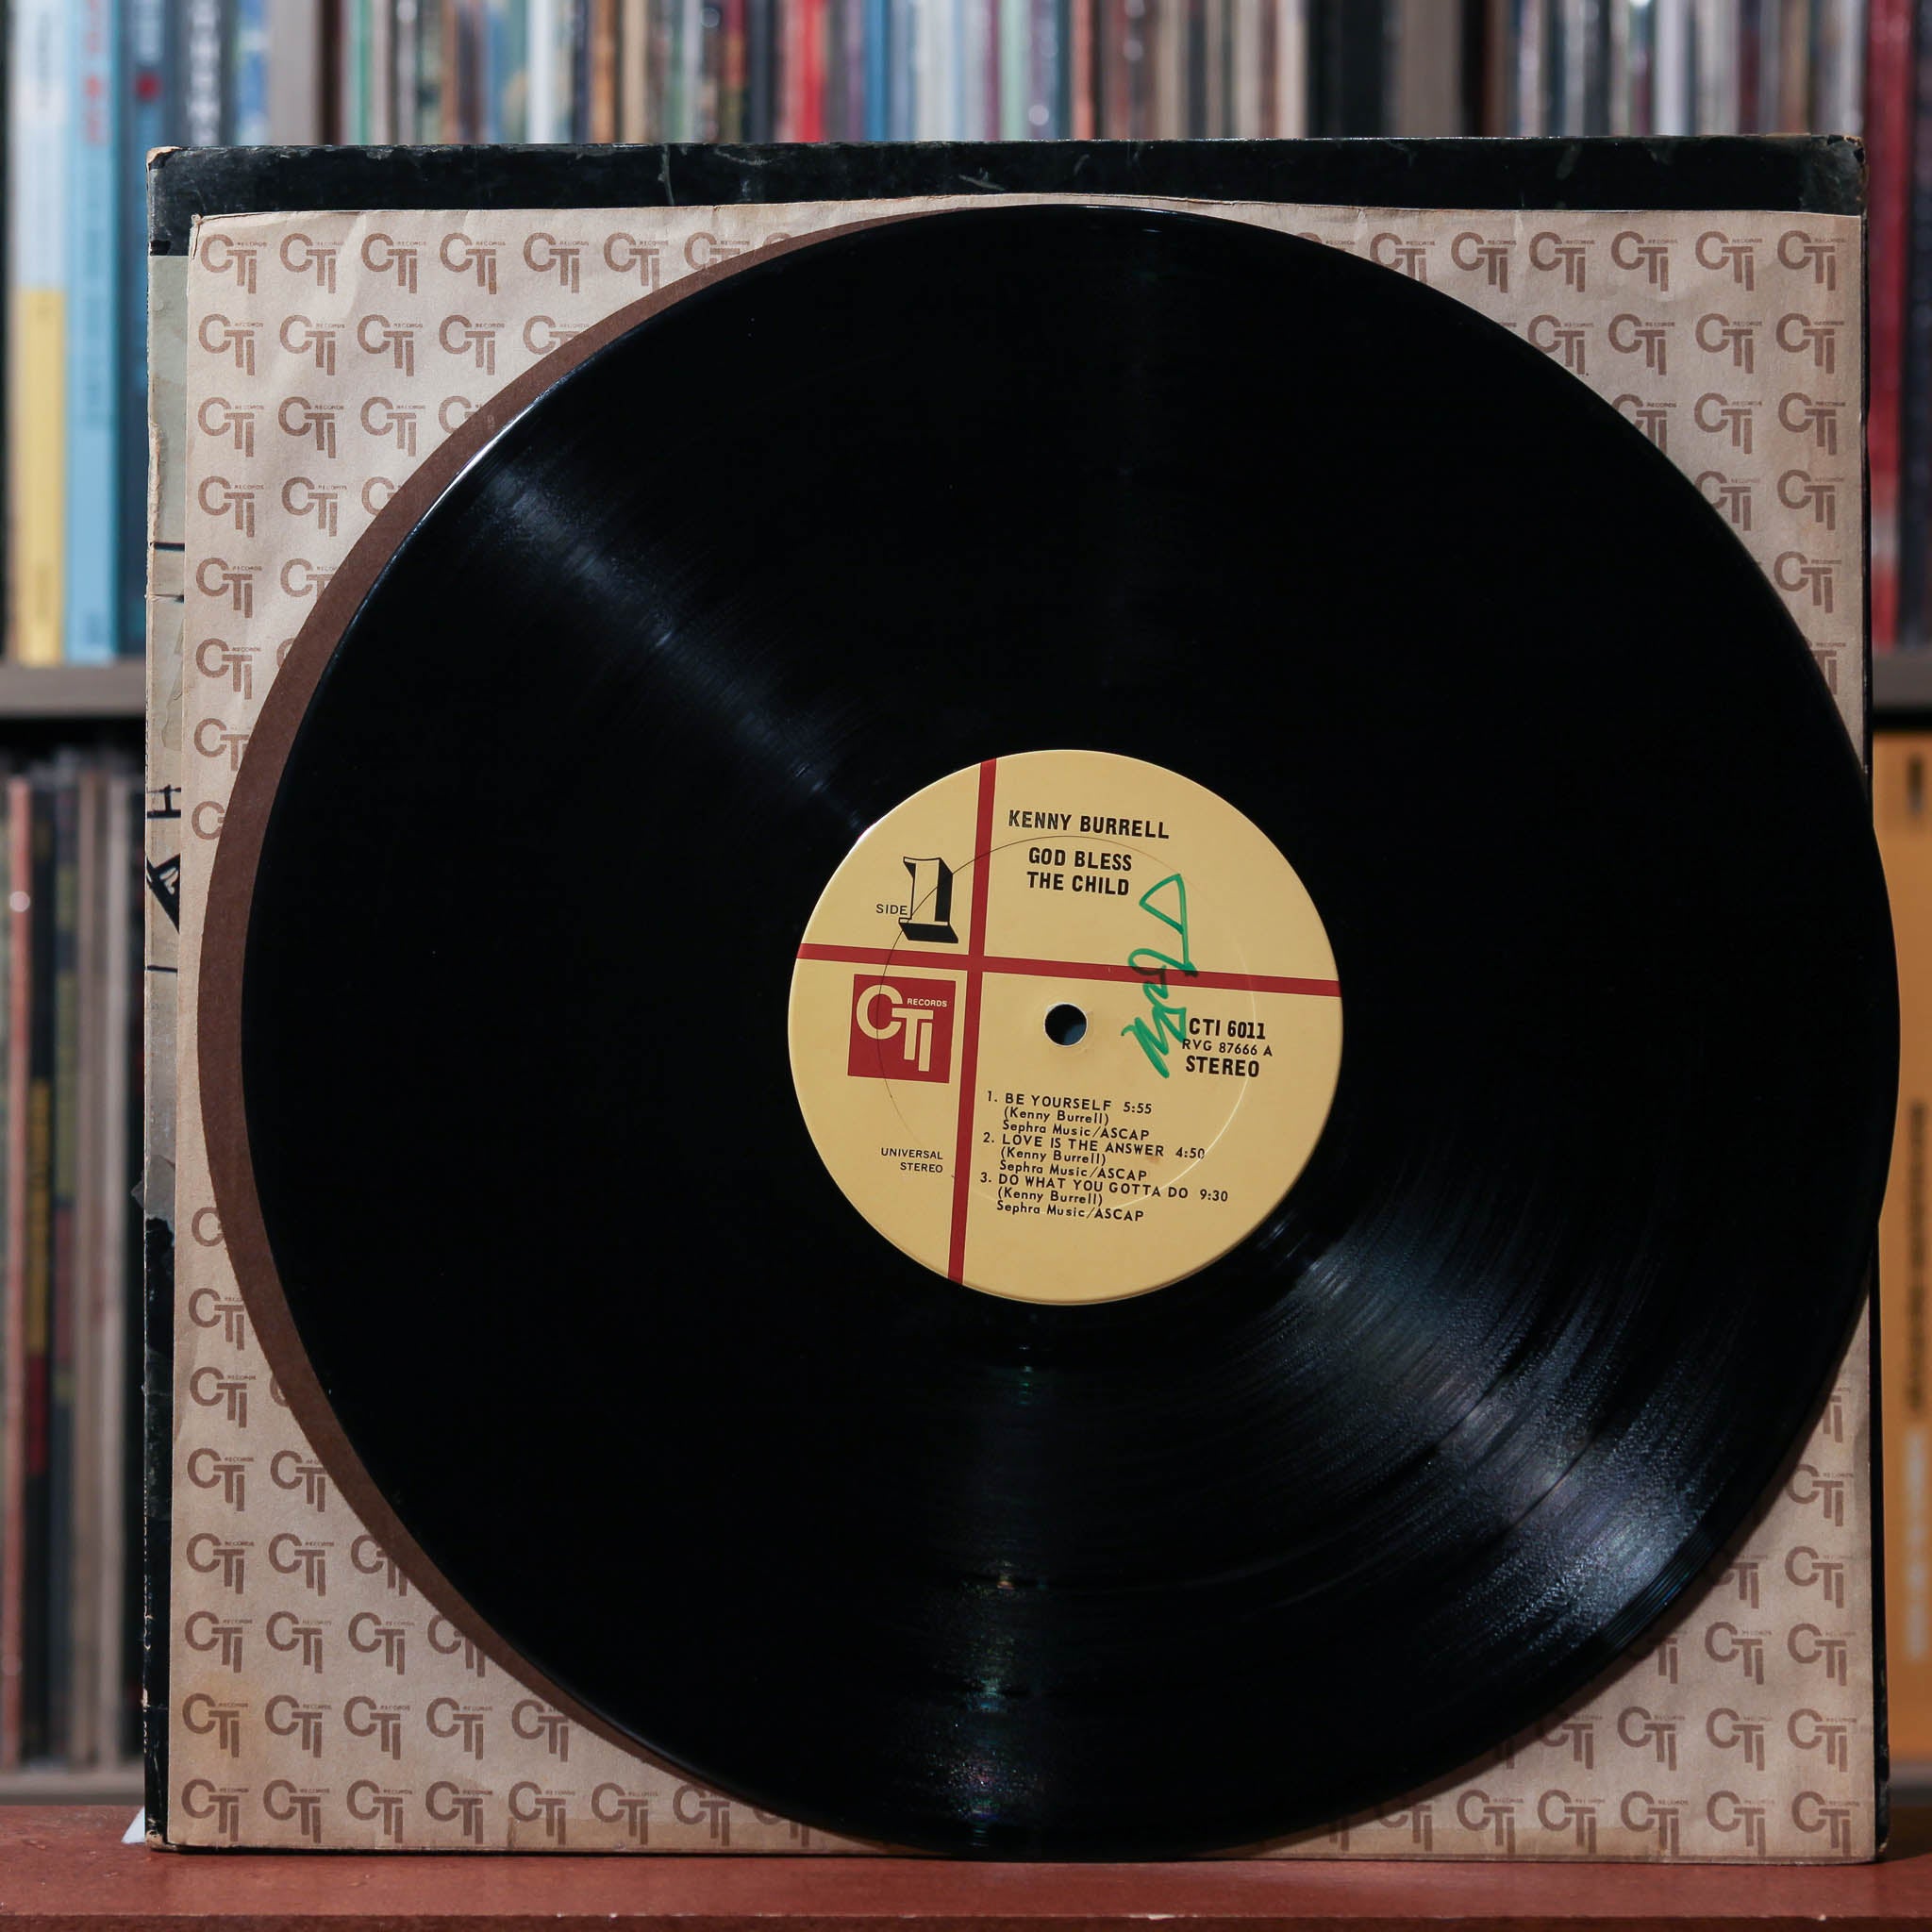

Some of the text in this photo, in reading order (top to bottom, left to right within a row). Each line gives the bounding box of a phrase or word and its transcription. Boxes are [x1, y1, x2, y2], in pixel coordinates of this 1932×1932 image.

[201, 235, 257, 293] CTI
[280, 233, 336, 293] CTI
[361, 233, 417, 293] CTI
[440, 233, 496, 294] CTI
[524, 233, 579, 292] CTI
[604, 232, 659, 291] CTI
[1370, 232, 1426, 282] CTI
[1451, 232, 1507, 293] CTI
[1529, 232, 1585, 292] CTI
[1611, 231, 1668, 291] CTI
[1695, 231, 1754, 291] CTI
[1777, 231, 1836, 291] CTI
[199, 314, 255, 375] CTI
[280, 315, 335, 375] CTI
[358, 315, 414, 376] CTI
[440, 315, 495, 375] CTI
[1528, 315, 1585, 375] CTI
[1608, 314, 1666, 375] CTI
[1696, 313, 1754, 374] CTI
[1776, 313, 1835, 374] CTI
[198, 398, 254, 457] CTI
[278, 397, 336, 458] CTI
[360, 397, 416, 456] CTI
[1694, 393, 1752, 454] CTI
[1778, 392, 1837, 455] CTI
[198, 476, 255, 538] CTI
[282, 477, 337, 537] CTI
[1695, 471, 1751, 530] CTI
[1777, 470, 1835, 530] CTI
[196, 558, 252, 618] CTI
[1774, 552, 1833, 613] CTI
[196, 639, 252, 699] CTI
[1008, 809, 1170, 840] KENNY BURRELL
[1026, 871, 1129, 896] THE CHILD
[1028, 847, 1132, 872] GOD BLESS
[875, 856, 959, 944] SIDE 1
[856, 984, 948, 1073] CTI RECORDS
[1182, 1039, 1273, 1058] RVG 87666 A
[1189, 1017, 1266, 1040] CTI 6011
[1185, 1055, 1260, 1078] STEREO
[987, 1091, 1152, 1115] 1. BE YOURSELF 5:55
[1002, 1119, 1046, 1134] Sephra
[1003, 1107, 1109, 1124] (Kenny Burrell)
[880, 1147, 943, 1160] UNIVERSAL
[900, 1161, 943, 1174] STEREO
[983, 1132, 1206, 1159] 2. LOVE IS THE ANSWER 4:50
[1000, 1146, 1107, 1165] (Kenny Burrell)
[1000, 1159, 1043, 1174] Sephra
[980, 1172, 1228, 1202] 3. DO WHAT YOU GOTTA DO 9:30
[996, 1200, 1041, 1215] Sephra
[997, 1186, 1103, 1207] (Kenny Burrell)
[189, 1288, 244, 1351] CTI
[190, 1367, 247, 1428] CTI
[188, 1448, 244, 1511] CTI
[271, 1450, 325, 1512] CTI
[187, 1533, 244, 1594] CTI
[269, 1533, 325, 1596] CTI
[1785, 1546, 1843, 1608] CTI
[185, 1611, 242, 1673] CTI
[266, 1611, 323, 1674] CTI
[348, 1612, 405, 1675] CTI
[1705, 1623, 1764, 1685] CTI
[1788, 1624, 1846, 1686] CTI
[182, 1693, 240, 1758] CTI
[265, 1695, 323, 1758] CTI
[343, 1696, 401, 1759] CTI
[426, 1697, 483, 1759] CTI
[511, 1700, 568, 1762] CTI
[1618, 1707, 1676, 1771] CTI
[1707, 1708, 1764, 1771] CTI
[1788, 1709, 1846, 1772] CTI
[181, 1779, 239, 1841] CTI
[263, 1780, 321, 1843] CTI
[347, 1780, 403, 1843] CTI
[425, 1781, 483, 1843] CTI
[508, 1781, 566, 1845] CTI
[591, 1783, 648, 1844] CTI
[673, 1784, 730, 1846] CTI
[1457, 1790, 1515, 1853] CTI
[1538, 1790, 1596, 1853] CTI
[1621, 1791, 1679, 1857] CTI
[1707, 1790, 1765, 1855] CTI
[1791, 1791, 1850, 1854] CTI
